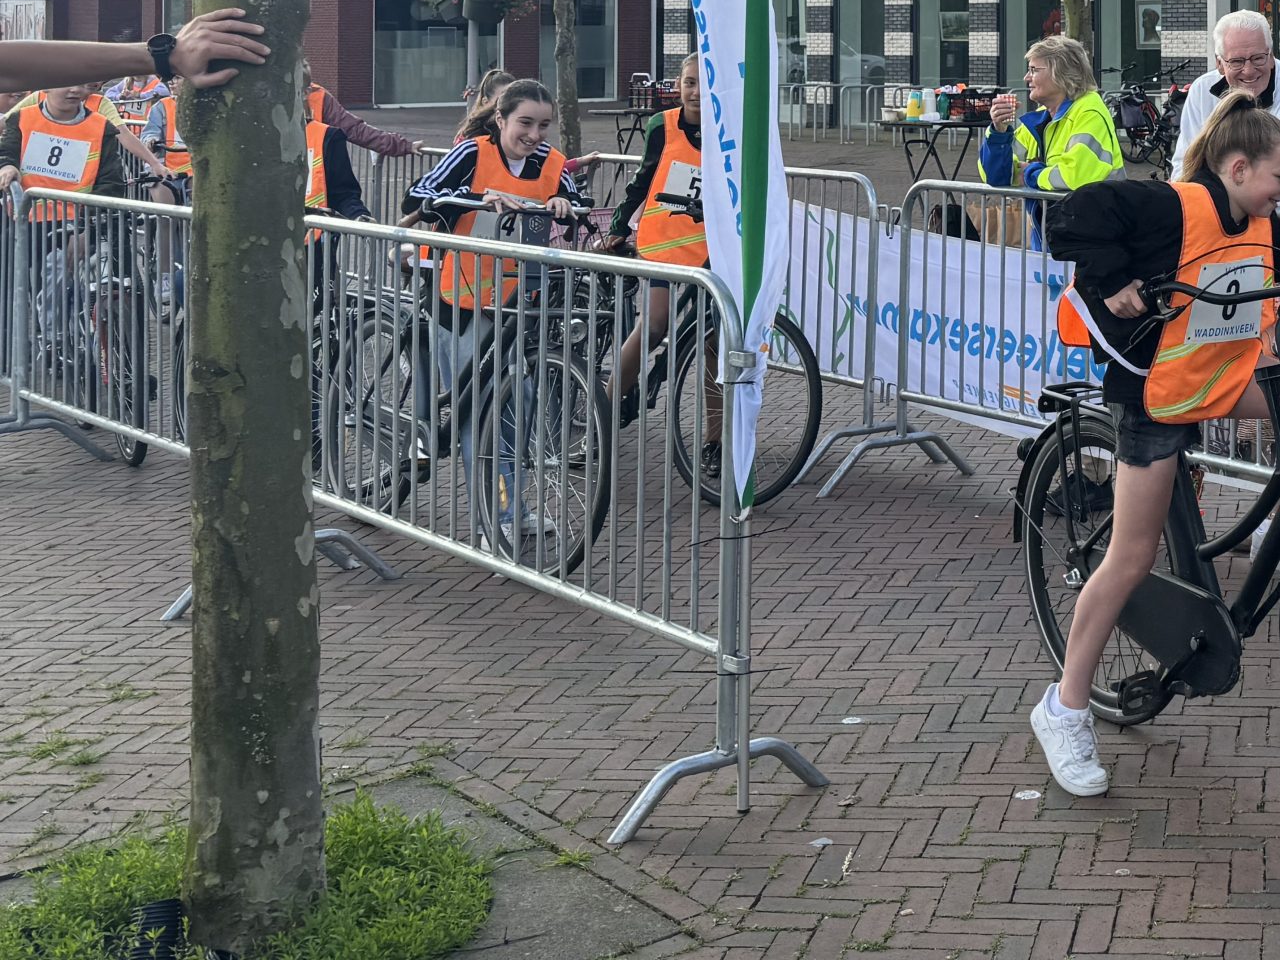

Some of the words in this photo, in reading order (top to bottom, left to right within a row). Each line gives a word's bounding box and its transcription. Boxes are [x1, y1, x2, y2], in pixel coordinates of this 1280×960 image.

[49, 136, 71, 147] VVN
[46, 145, 63, 167] 8
[26, 165, 77, 180] WADDINXVEEN
[687, 176, 702, 200] 5
[501, 212, 518, 237] 4
[1194, 322, 1256, 338] WADDINXVEEN
